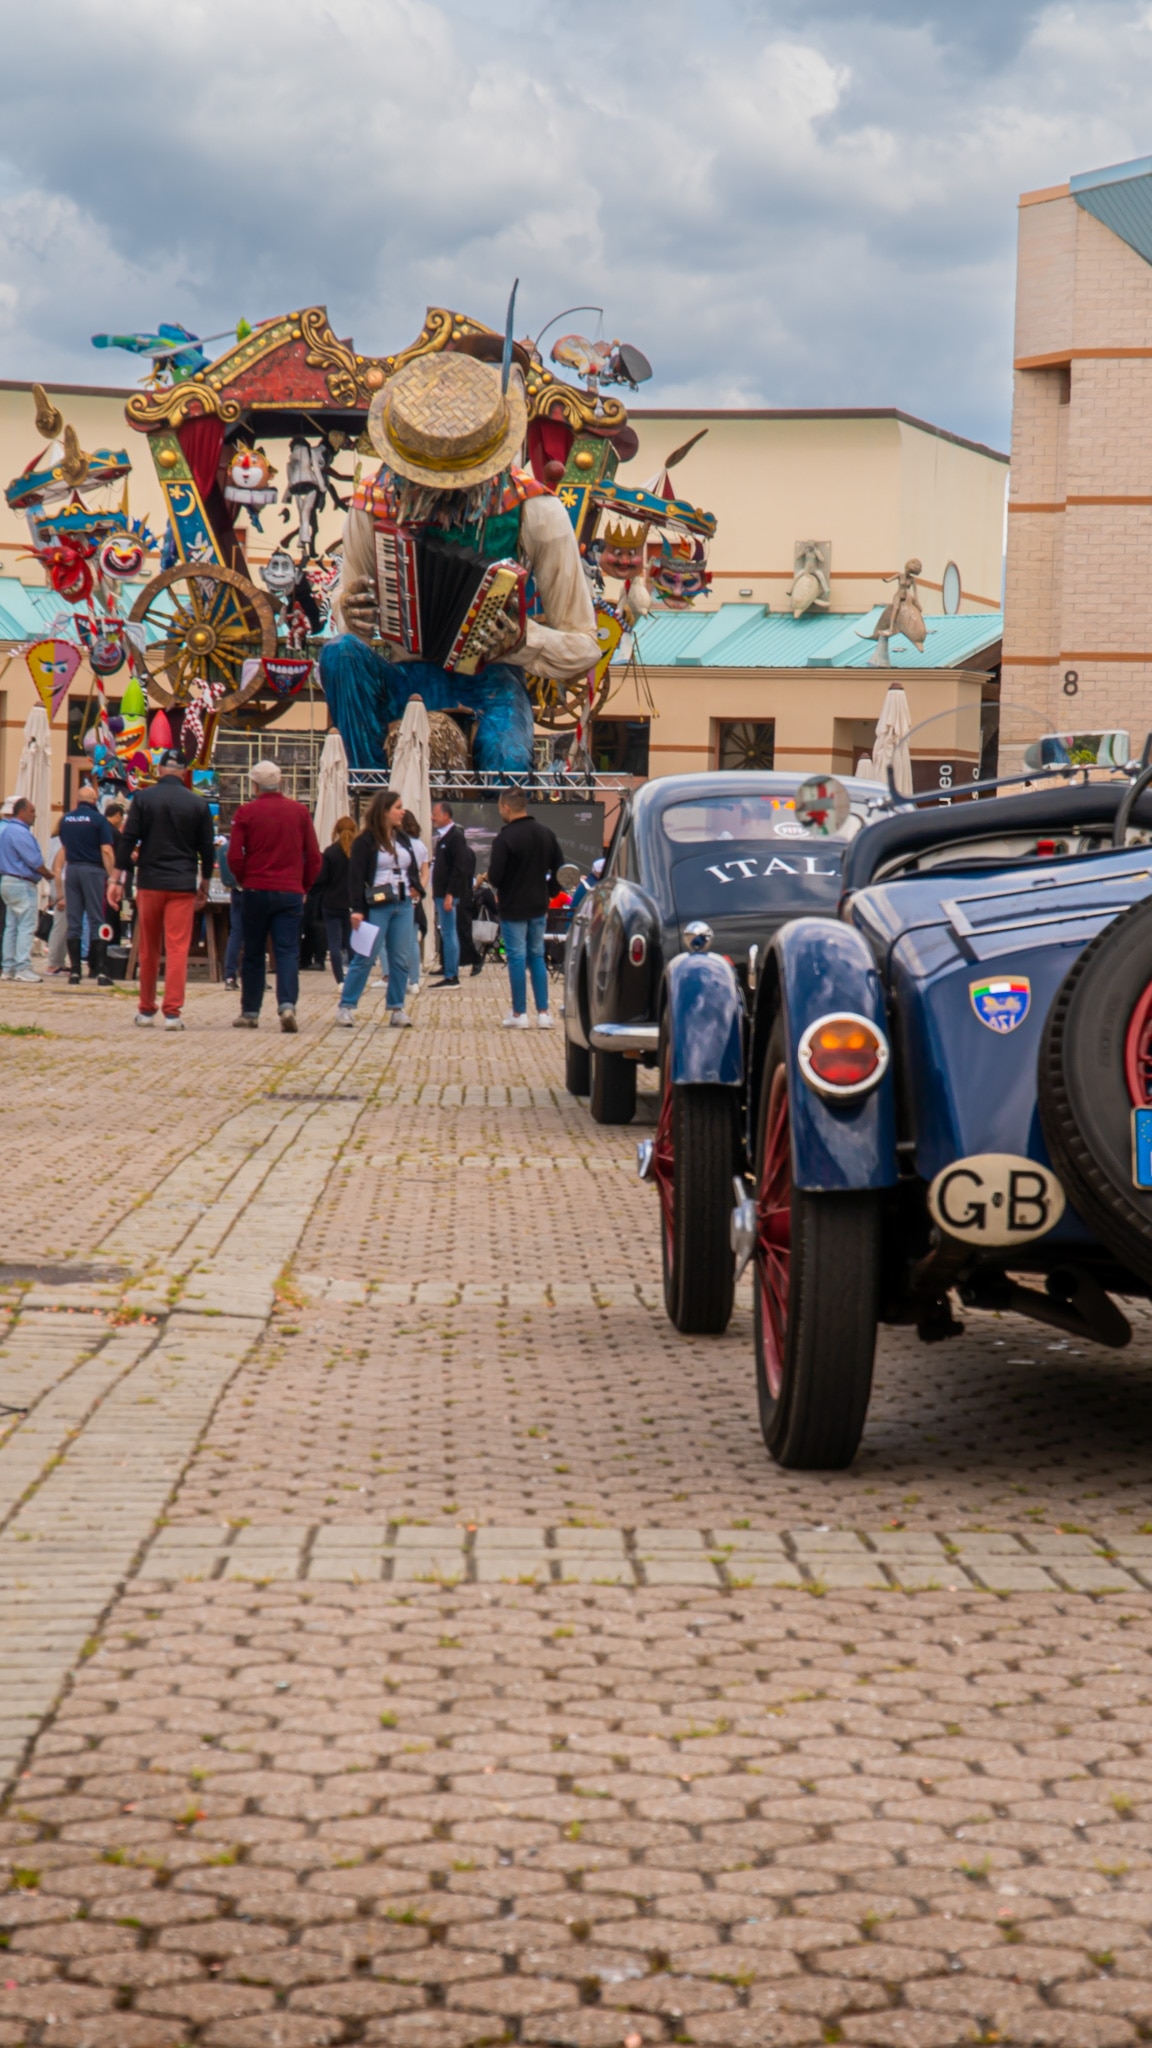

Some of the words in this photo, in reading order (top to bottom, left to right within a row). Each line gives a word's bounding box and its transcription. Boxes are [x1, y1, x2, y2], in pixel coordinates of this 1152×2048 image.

[1063, 670, 1079, 697] 8
[939, 764, 953, 808] ueo
[704, 856, 842, 884] ITAL
